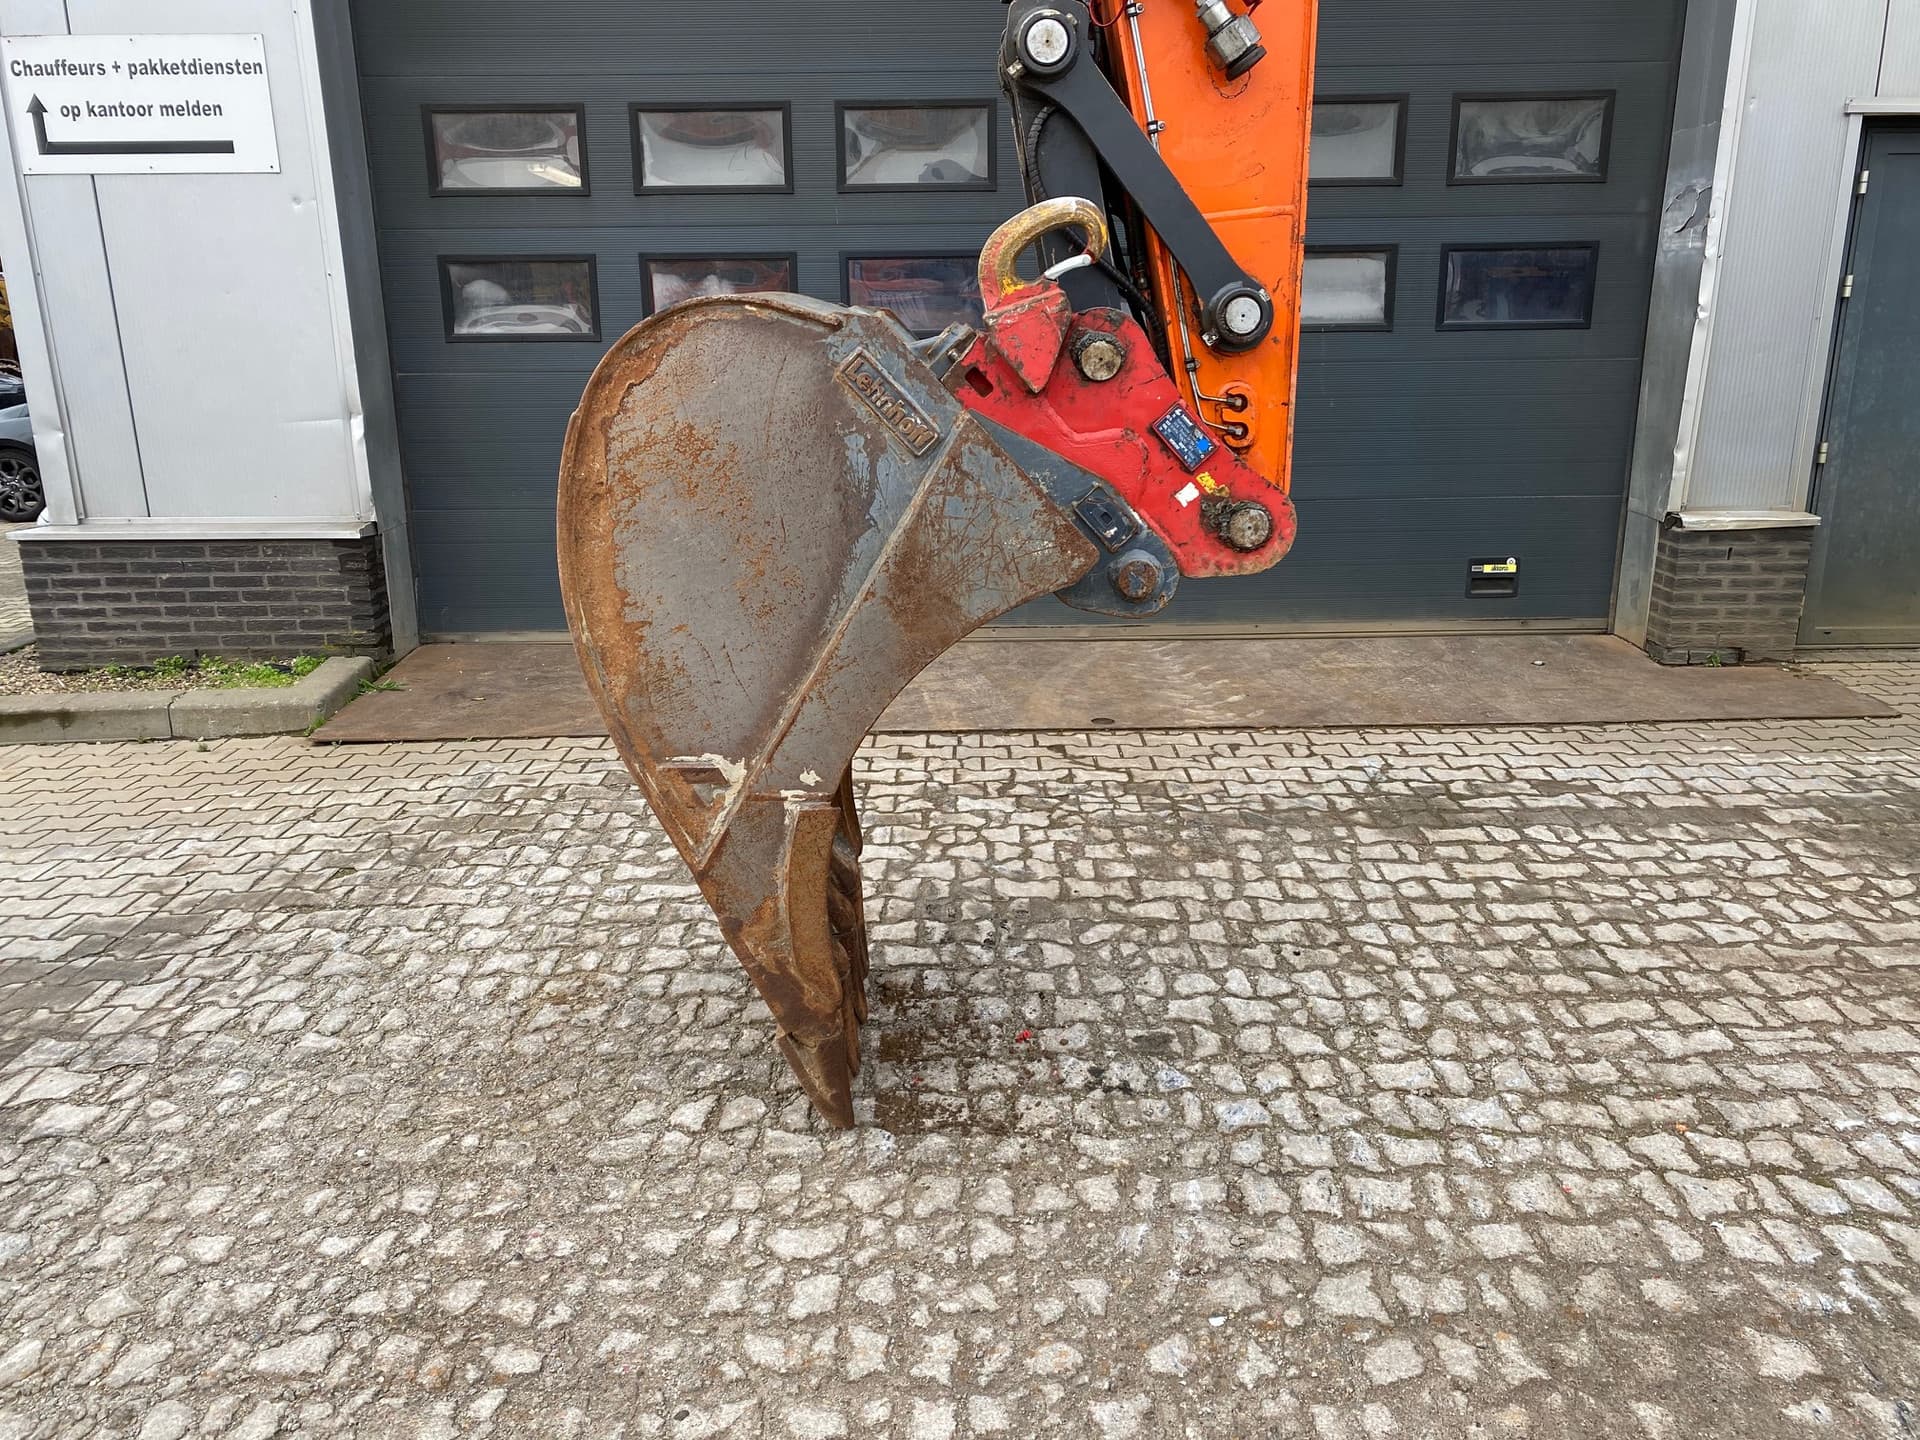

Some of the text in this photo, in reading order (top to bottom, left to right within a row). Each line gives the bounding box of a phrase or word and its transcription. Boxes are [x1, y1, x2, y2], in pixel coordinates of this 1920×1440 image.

[10, 58, 263, 79] Chauffeurs + pakketdiensten
[60, 100, 223, 121] op kantoor melden
[845, 358, 933, 447] Lehnhoff
